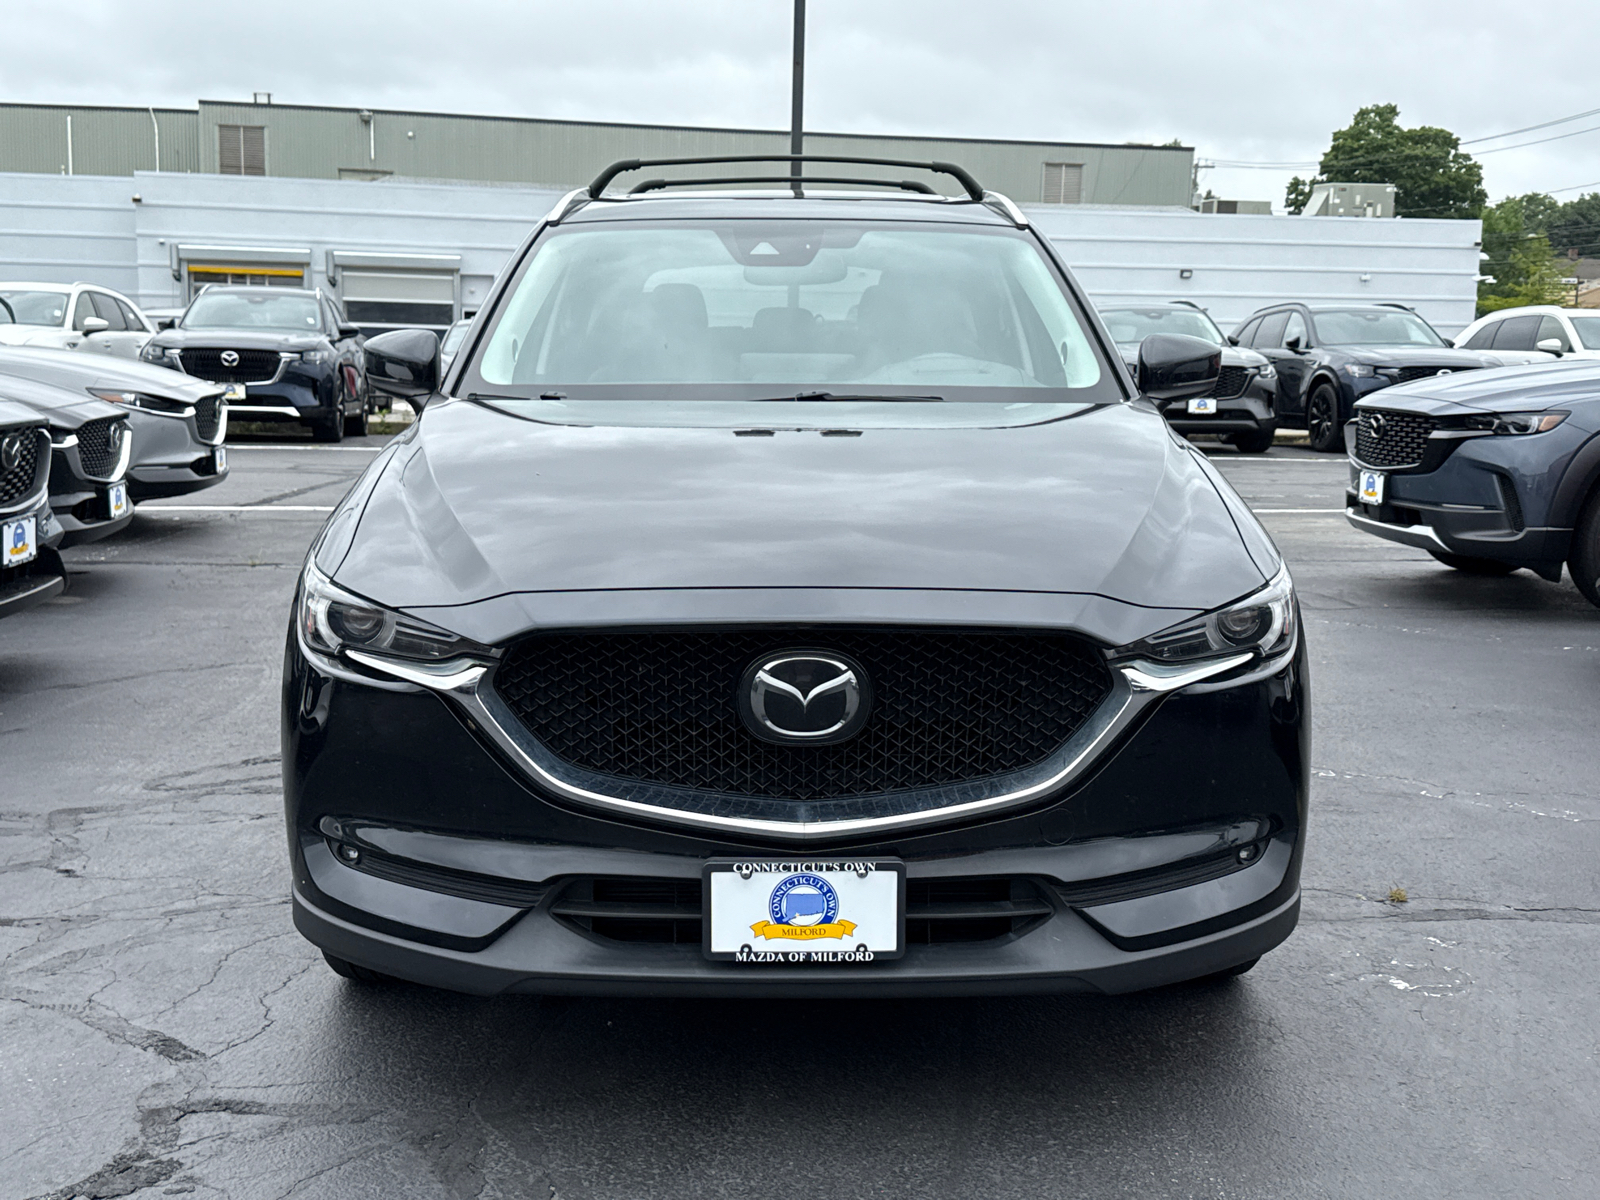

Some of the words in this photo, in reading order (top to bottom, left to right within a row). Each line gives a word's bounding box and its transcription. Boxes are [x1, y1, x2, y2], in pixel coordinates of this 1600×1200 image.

[732, 862, 840, 873] CONNECTICUT'S
[844, 862, 876, 873] OWN
[772, 876, 829, 918] CONNECTICUT'S
[826, 892, 836, 918] OWN
[781, 928, 827, 937] MILFORD
[735, 951, 785, 963] MAZDA
[788, 951, 807, 963] OF
[810, 951, 875, 963] MILFORD
